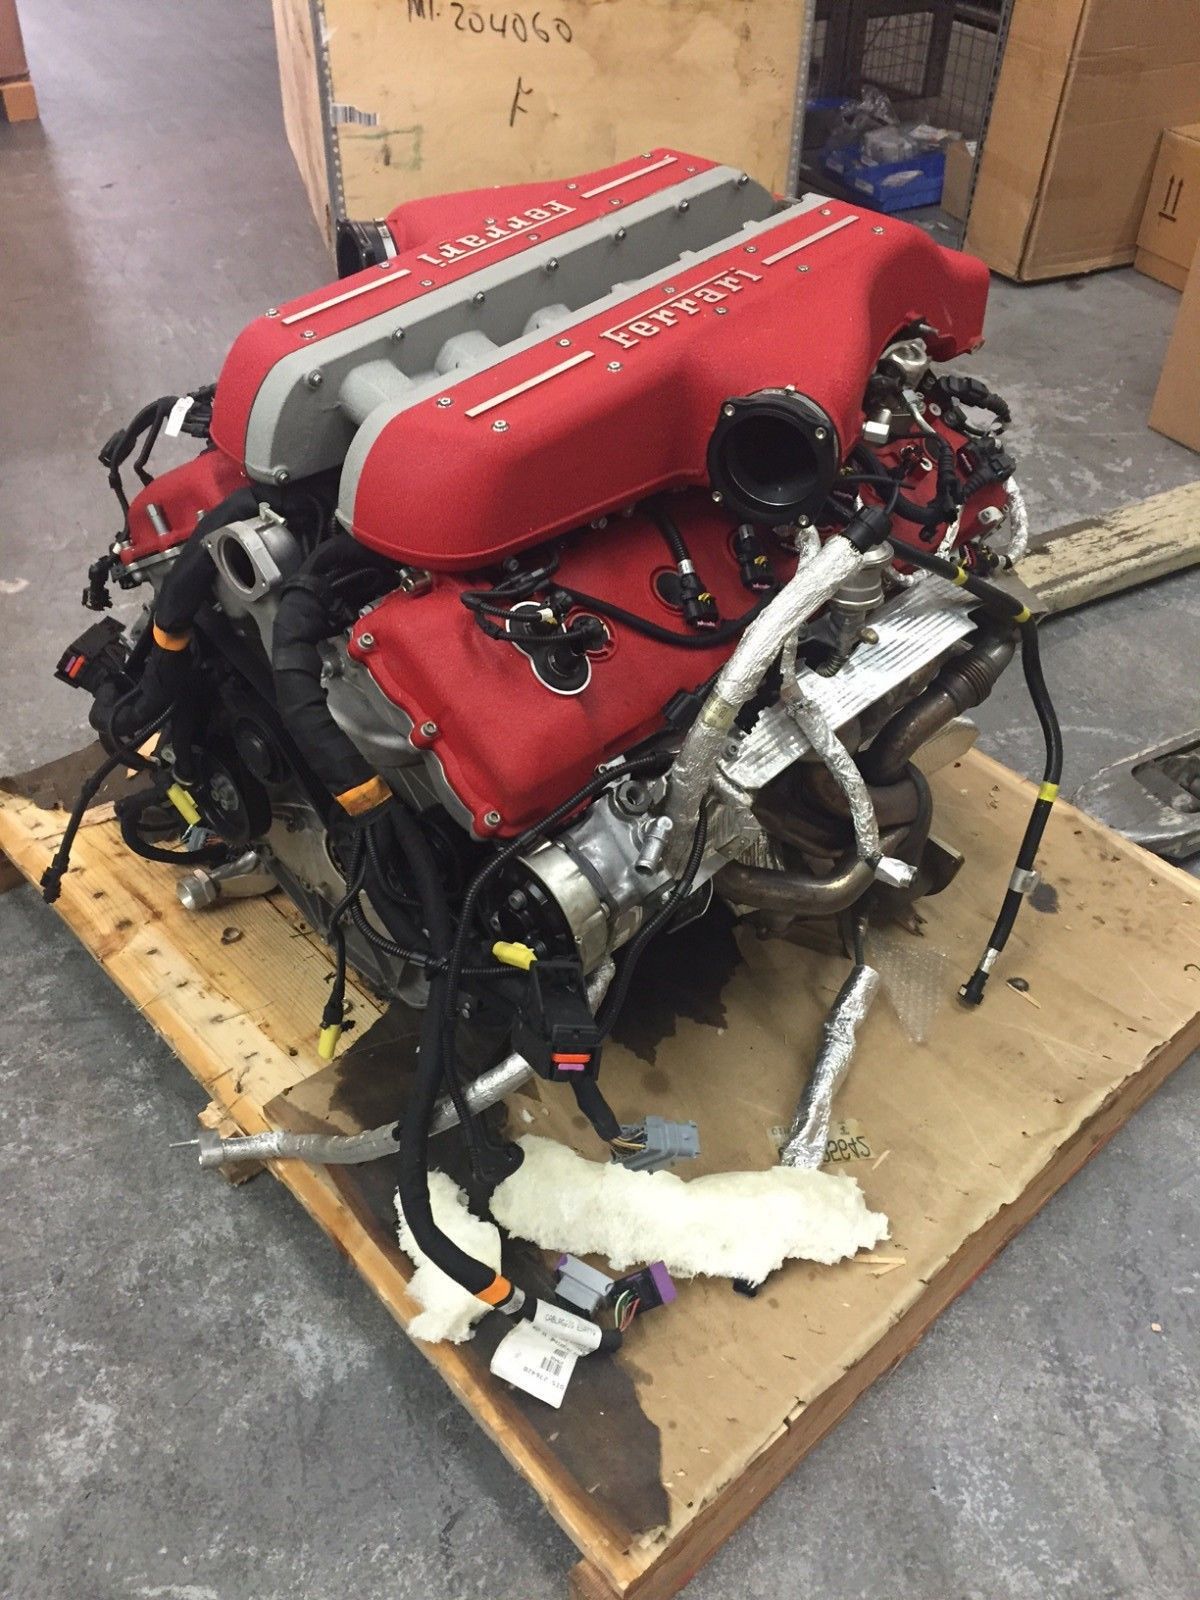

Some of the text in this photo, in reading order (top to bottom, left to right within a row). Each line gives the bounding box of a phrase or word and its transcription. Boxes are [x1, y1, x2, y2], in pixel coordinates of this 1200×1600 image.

[451, 2, 573, 43] 204060
[416, 199, 577, 268] Ferrari
[600, 267, 763, 349] Ferrari
